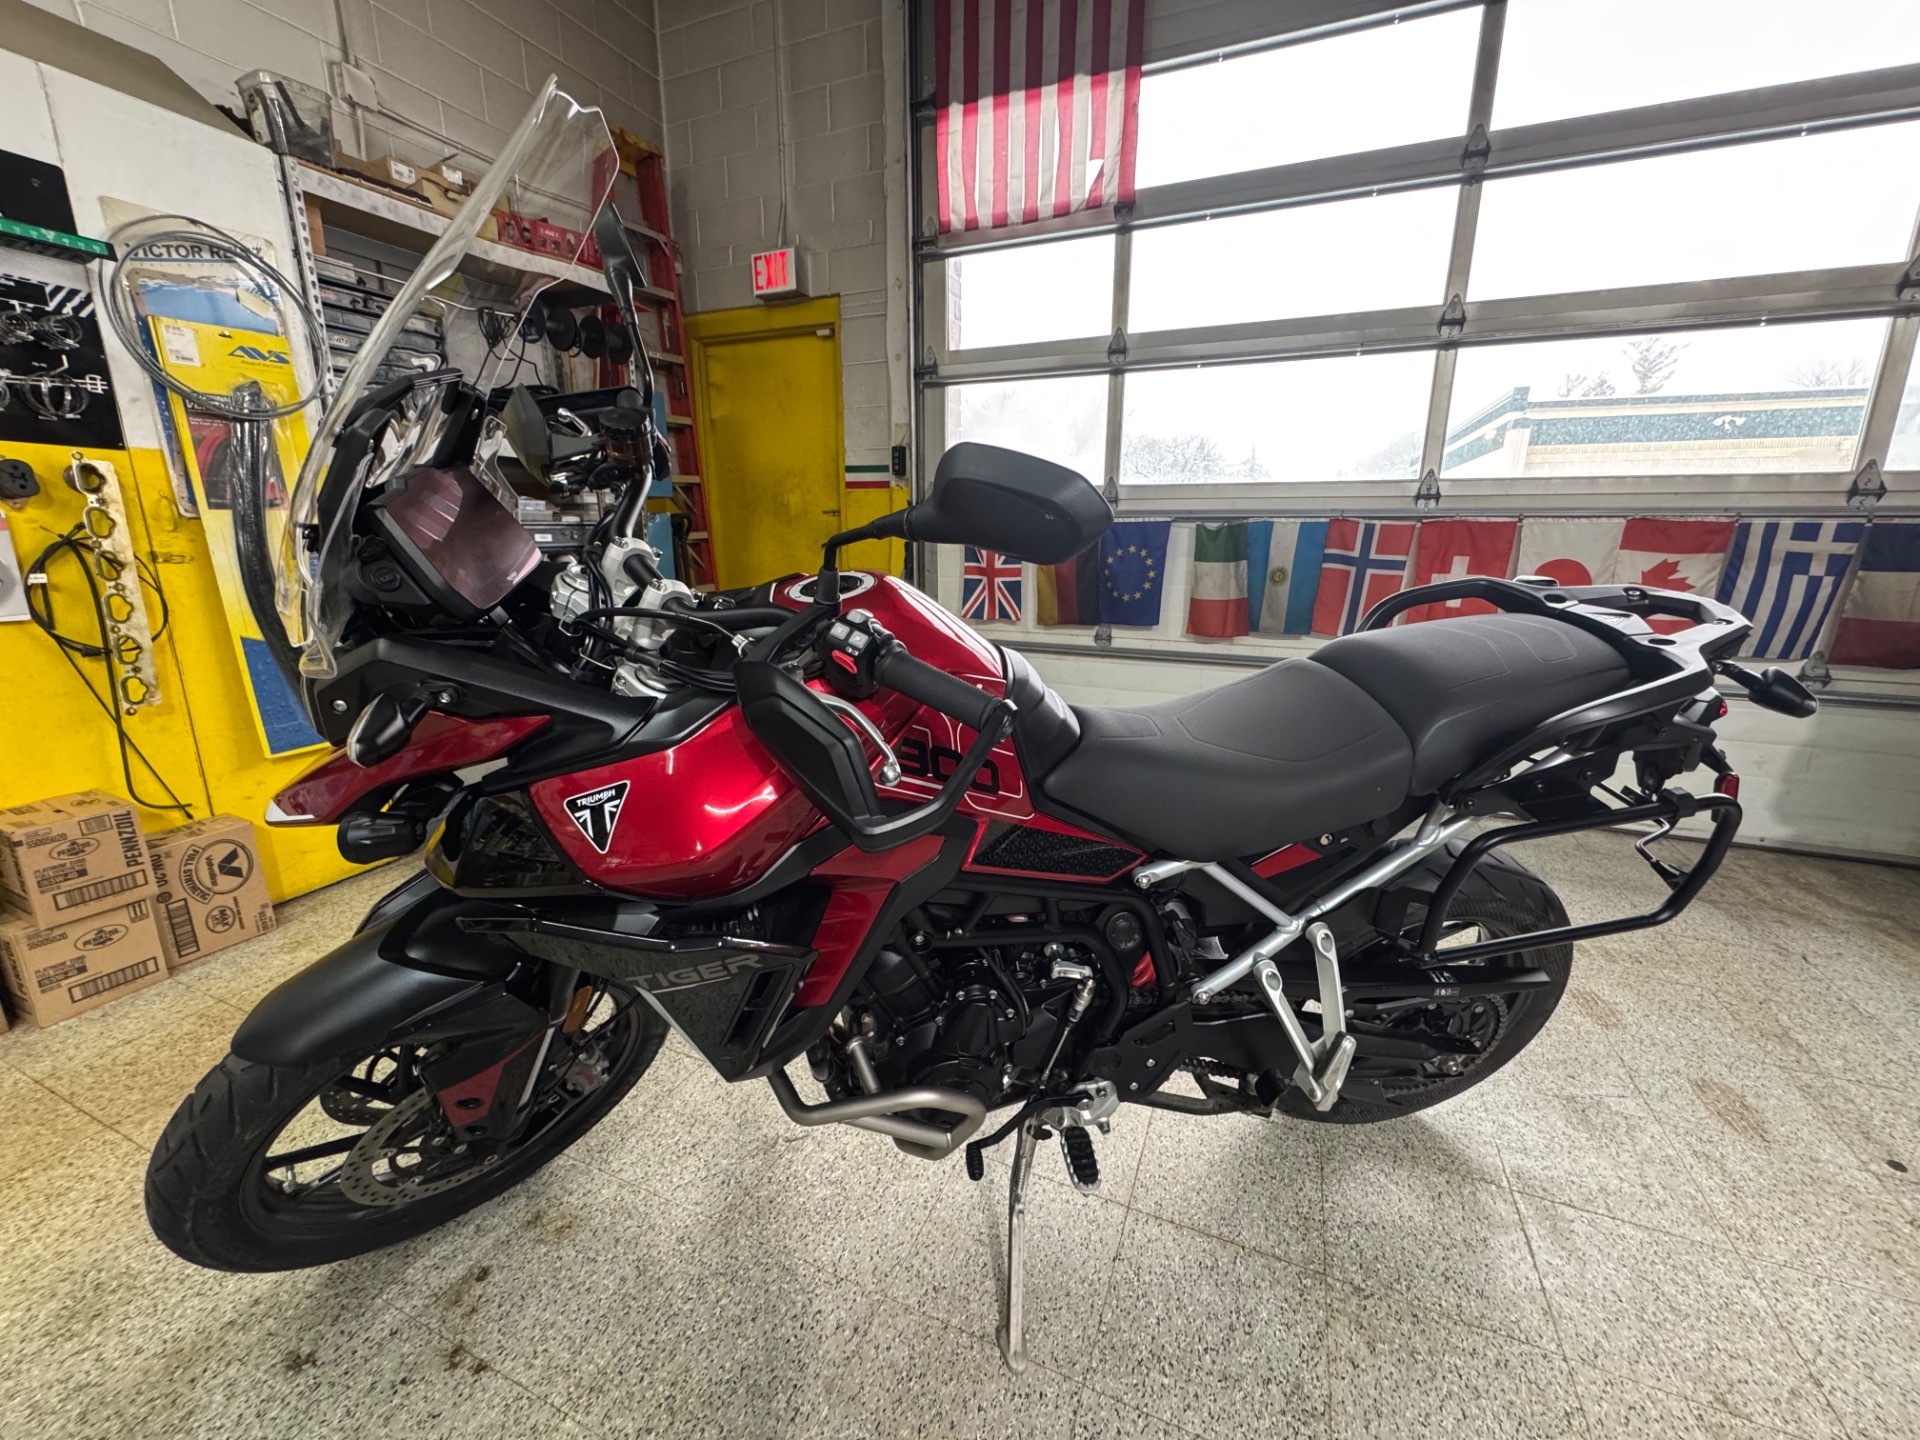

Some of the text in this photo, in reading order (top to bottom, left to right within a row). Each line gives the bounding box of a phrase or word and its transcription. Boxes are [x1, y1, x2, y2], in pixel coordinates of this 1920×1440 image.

[753, 250, 788, 291] EXIT
[228, 345, 290, 364] AVS
[576, 788, 616, 807] TRIUMPH
[113, 810, 144, 868] PENNZOIL
[183, 848, 211, 901] FULL SYNTHETIC
[205, 854, 218, 887] Valvoline
[217, 909, 231, 928] MAX
[625, 953, 763, 990] TIGER
